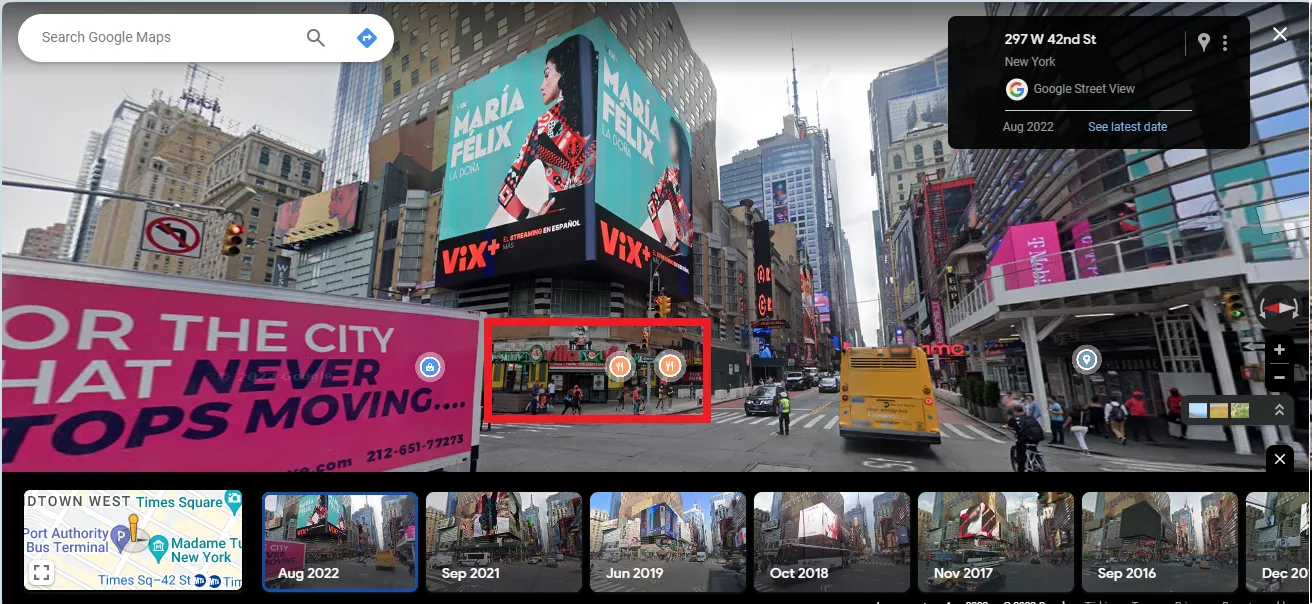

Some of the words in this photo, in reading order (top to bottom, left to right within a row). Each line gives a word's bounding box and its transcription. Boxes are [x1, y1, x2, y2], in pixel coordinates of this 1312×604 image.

[454, 84, 524, 139] MARÍA
[603, 55, 660, 142] MARÍA
[450, 120, 513, 169] FÉLIX
[543, 225, 551, 233] EN
[277, 263, 289, 287] WES
[2, 305, 134, 351] OR
[160, 314, 288, 352] THE
[304, 322, 395, 353] CITY
[2, 360, 173, 404] HAT
[183, 358, 380, 396] NEVER
[2, 403, 229, 463] TOPS
[367, 434, 465, 463] 212-651-77273
